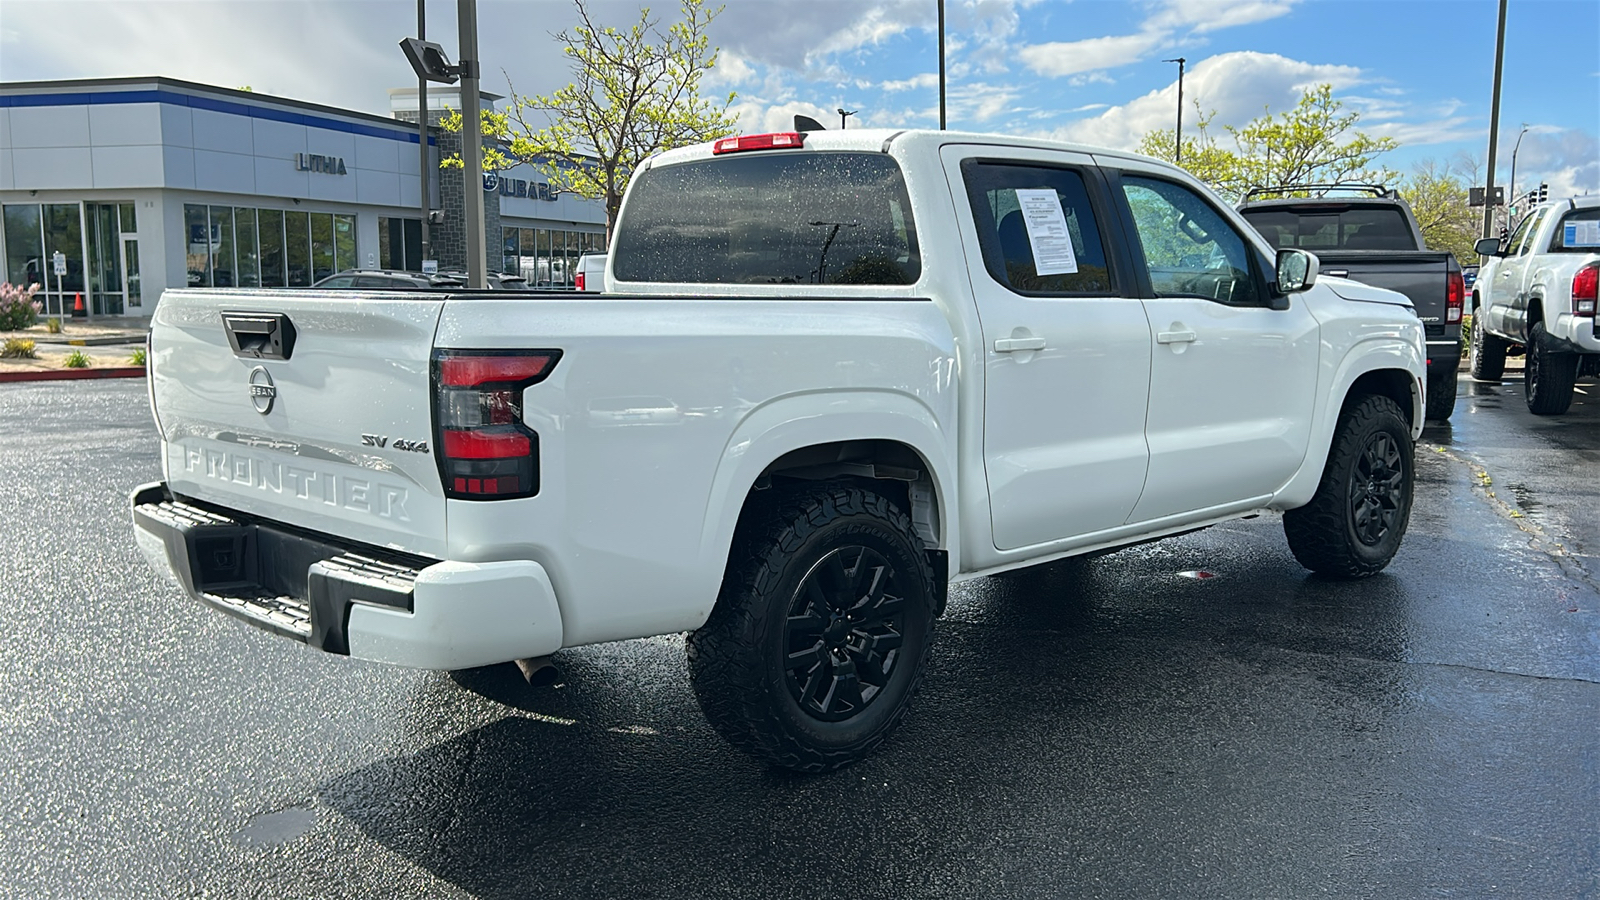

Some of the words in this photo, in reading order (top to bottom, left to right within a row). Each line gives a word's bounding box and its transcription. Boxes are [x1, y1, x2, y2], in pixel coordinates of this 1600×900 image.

[294, 153, 347, 175] LITHIA
[249, 386, 274, 397] SSAN
[361, 433, 388, 448] SV
[184, 444, 411, 521] FRONTIER
